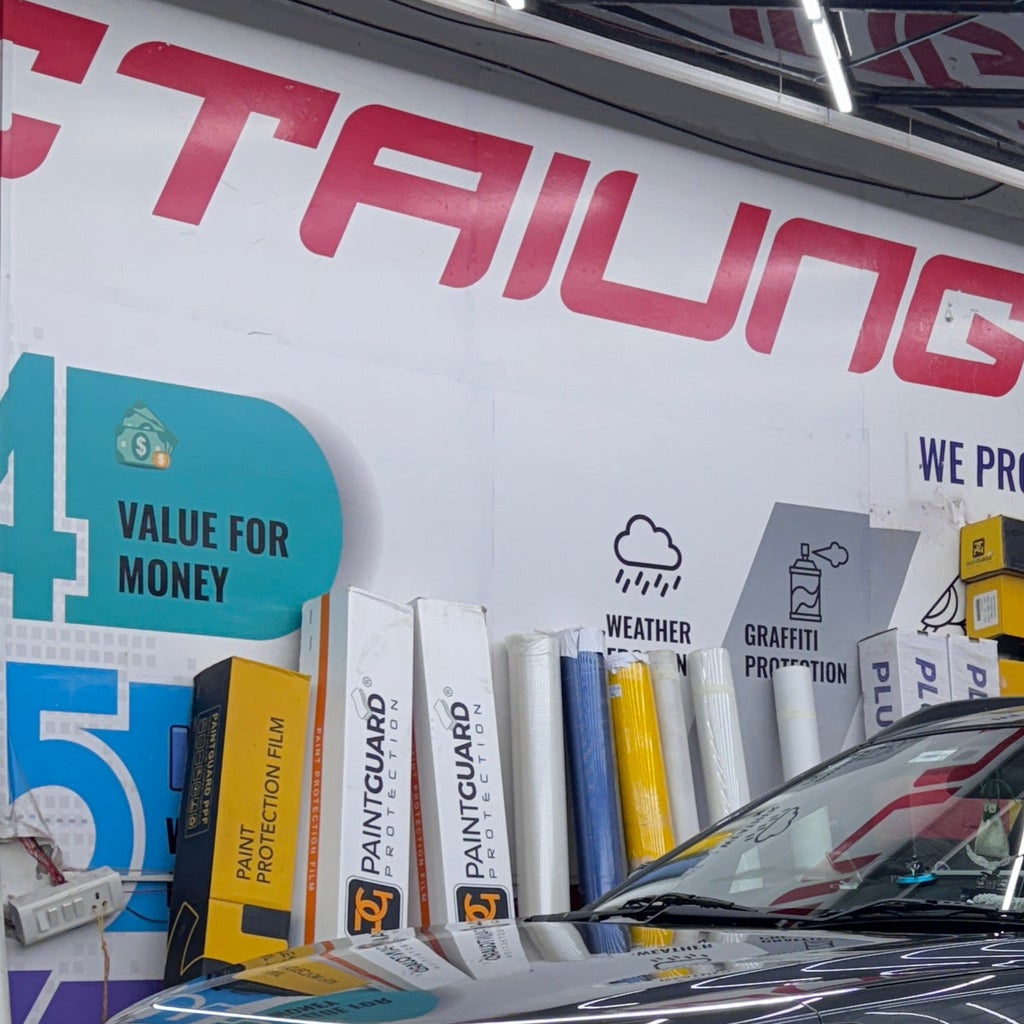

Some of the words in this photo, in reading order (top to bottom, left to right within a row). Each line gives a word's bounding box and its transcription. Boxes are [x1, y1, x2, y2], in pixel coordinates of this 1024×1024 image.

[919, 436, 965, 486] WE
[118, 500, 218, 551] VALUE
[229, 516, 289, 559] FOR
[118, 555, 229, 604] MONEY
[606, 614, 692, 645] WEATHER
[745, 623, 818, 652] GRAFFITI
[873, 661, 893, 728] PLU
[314, 727, 323, 764] PAINT
[256, 764, 280, 884] PROTECTION
[271, 716, 285, 760] FILM
[310, 770, 321, 855] PROTECTION
[361, 693, 386, 875] PAINTGUARD
[385, 698, 399, 877] PROTECTION
[450, 701, 485, 879] PAINTGUARD
[474, 703, 498, 879] PROTECTION
[236, 824, 255, 881] PAINT
[308, 862, 316, 892] FILM
